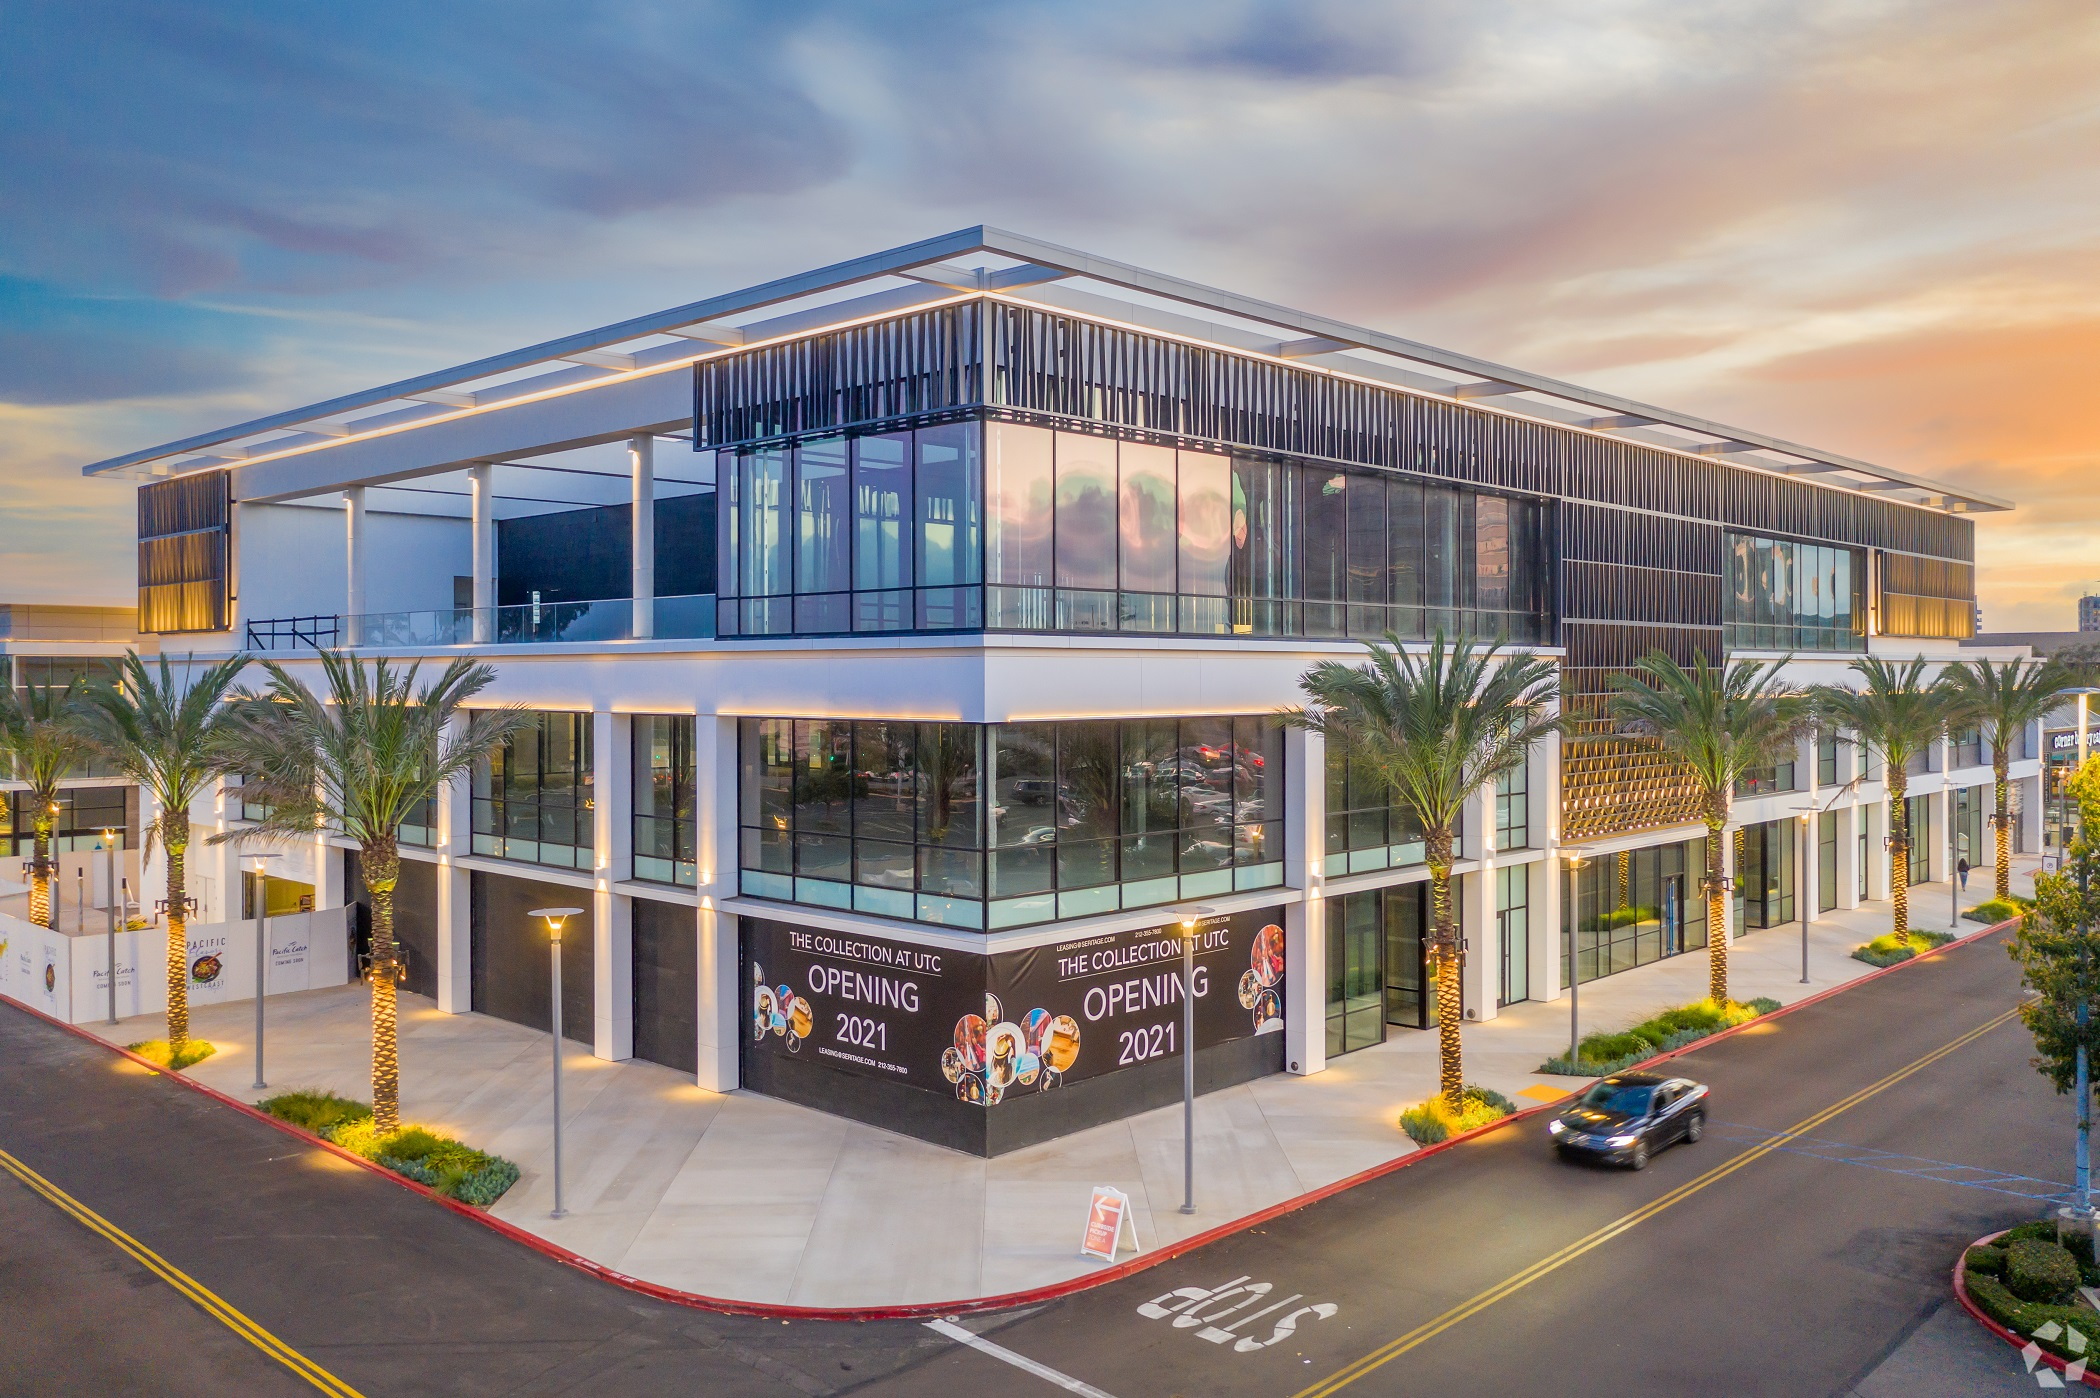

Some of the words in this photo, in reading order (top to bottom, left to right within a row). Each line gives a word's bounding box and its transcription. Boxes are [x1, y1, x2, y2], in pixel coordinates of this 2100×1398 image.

[2054, 735, 2074, 748] corner
[187, 937, 226, 949] PACIFIC
[272, 947, 291, 956] Pacific
[291, 945, 308, 953] Catch
[790, 932, 812, 949] THE
[815, 936, 892, 963] COLLECTION
[895, 950, 911, 966] AT
[915, 952, 942, 972] UTC
[1056, 936, 1116, 952] LEASING@SERITAGE.COM
[1058, 954, 1088, 977] THE
[1092, 937, 1181, 970] COLLECTION
[1204, 928, 1229, 949] UTC
[116, 967, 135, 975] Catch
[808, 964, 919, 1013] OPENING
[1083, 965, 1208, 1021] OPENING
[836, 1013, 886, 1051] 2021
[1118, 1021, 1175, 1066] 2021
[818, 1047, 876, 1067] LEASING@SERITAGE.COM
[1089, 1227, 1108, 1237] PICKUP
[1091, 1221, 1115, 1233] CURBSIDE
[1137, 1275, 1339, 1352] STOP
